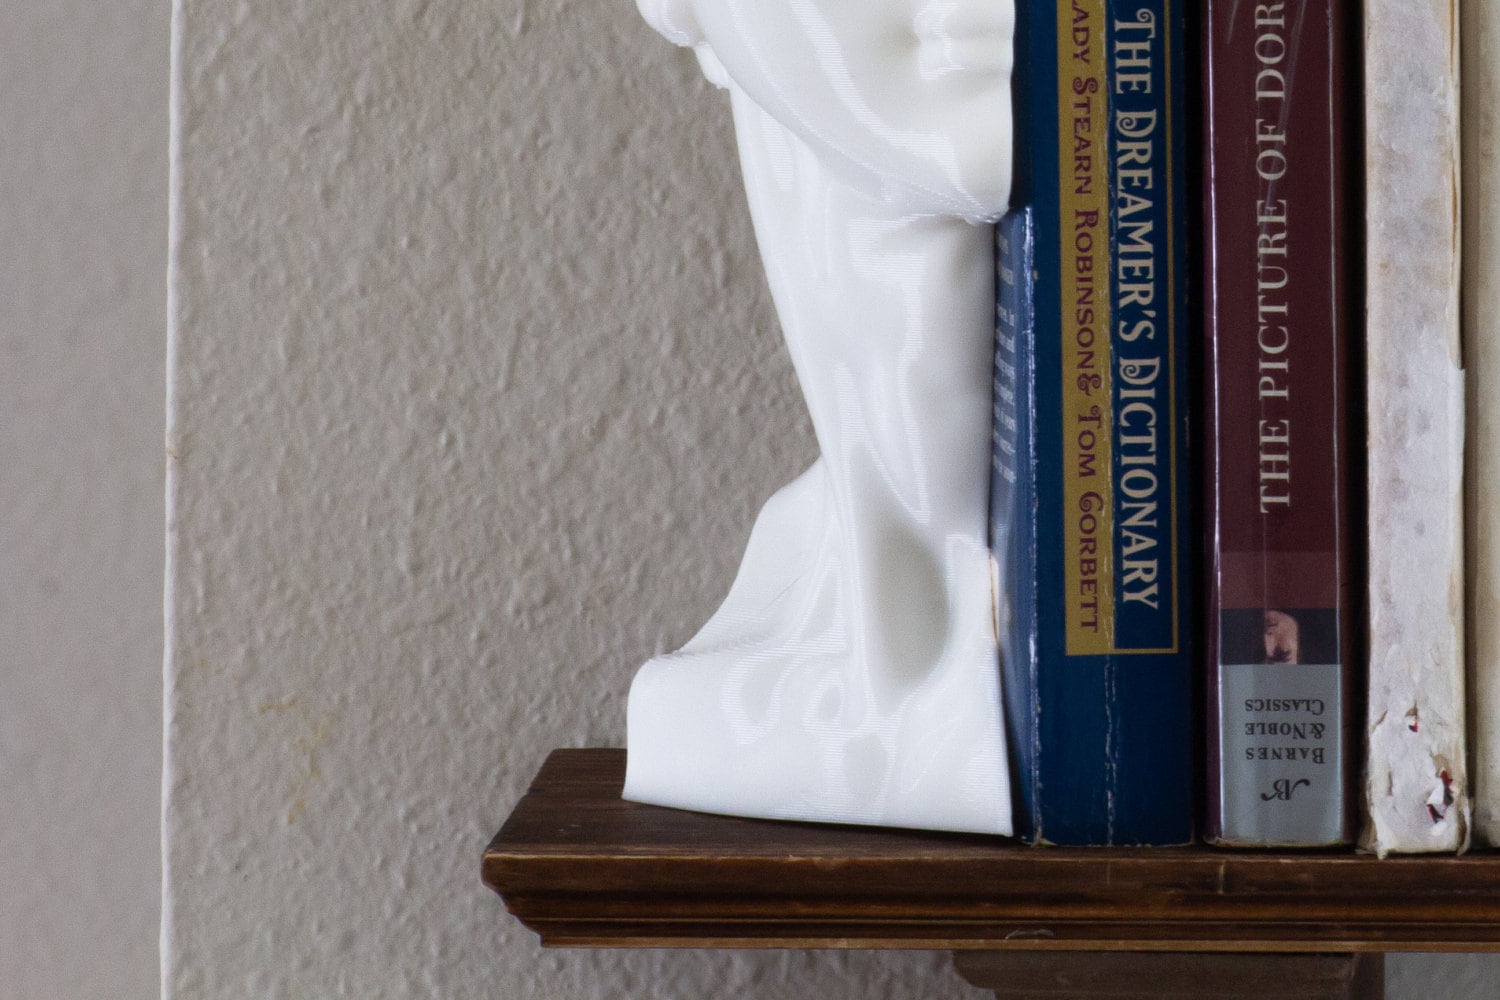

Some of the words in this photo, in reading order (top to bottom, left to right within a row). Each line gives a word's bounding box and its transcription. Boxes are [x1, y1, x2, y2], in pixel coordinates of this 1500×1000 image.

[1113, 6, 1157, 96] THE
[1072, 75, 1100, 196] STEARN
[1255, 117, 1288, 182] OF
[1115, 107, 1157, 343] DREAMER'S
[1256, 198, 1290, 401] PICTURE
[1076, 404, 1103, 480] TOM
[1118, 356, 1161, 611] DICTIONARY
[1258, 418, 1291, 515] THE
[1245, 698, 1325, 715] CLASSICS
[1246, 746, 1325, 764] BARNES
